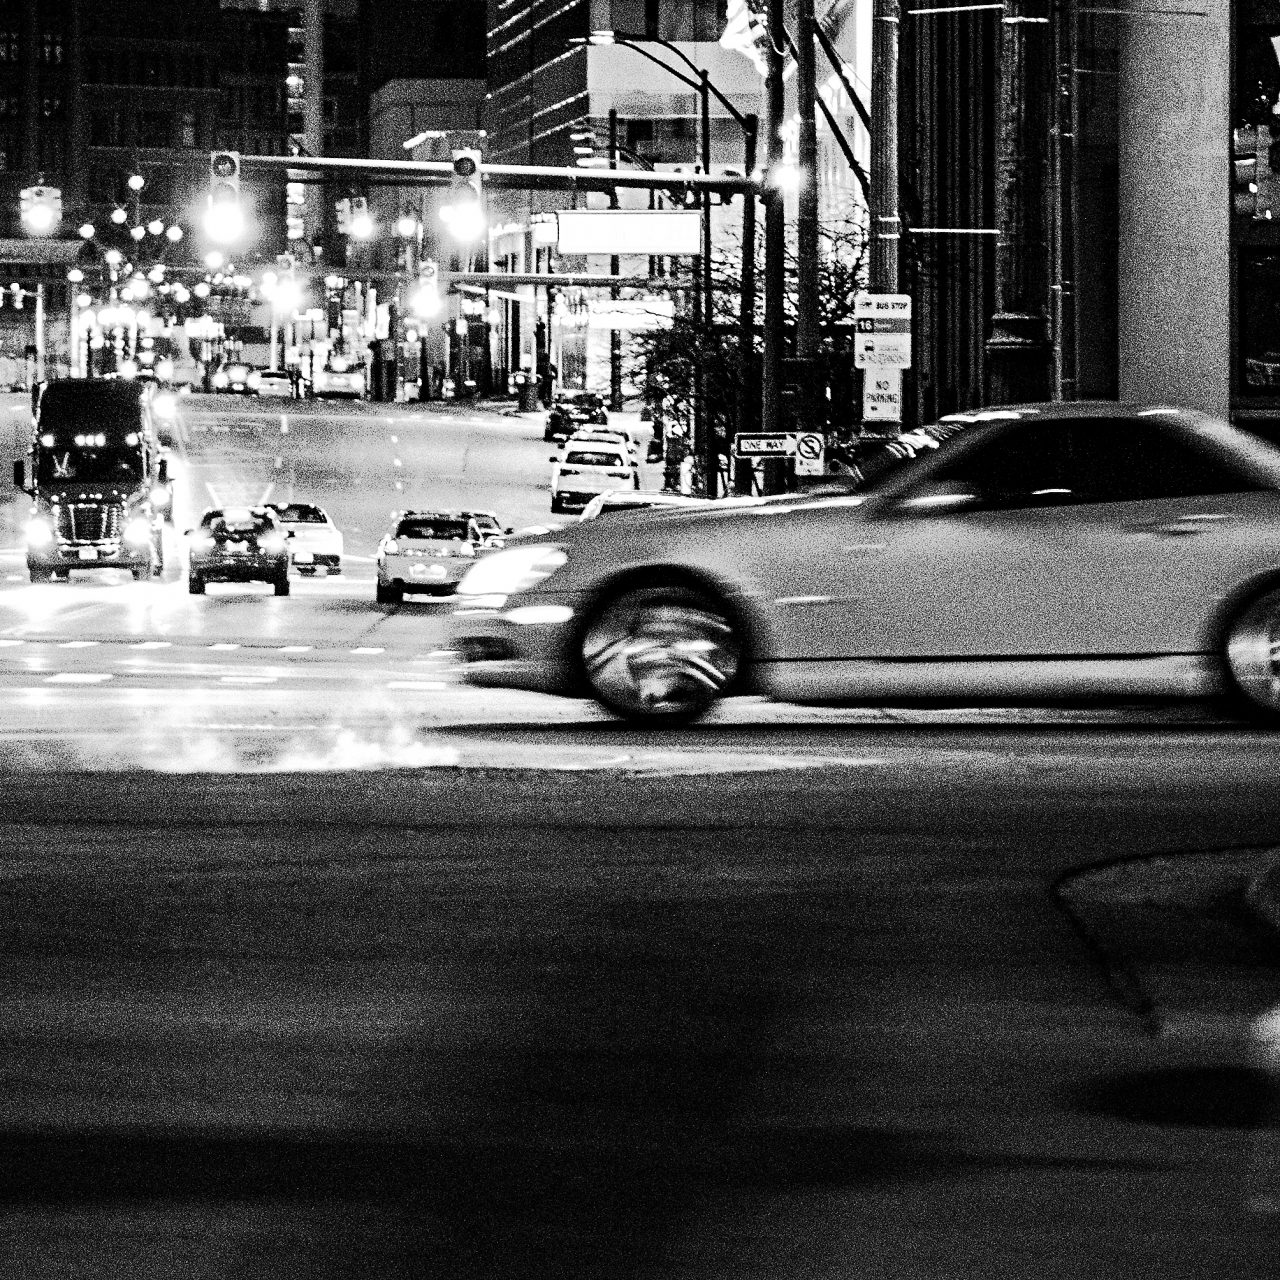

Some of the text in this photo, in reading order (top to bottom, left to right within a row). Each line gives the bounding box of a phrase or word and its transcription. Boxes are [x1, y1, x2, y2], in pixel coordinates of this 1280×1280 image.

[859, 320, 872, 331] 16
[876, 380, 889, 391] NO
[743, 440, 784, 450] ONE WAY
